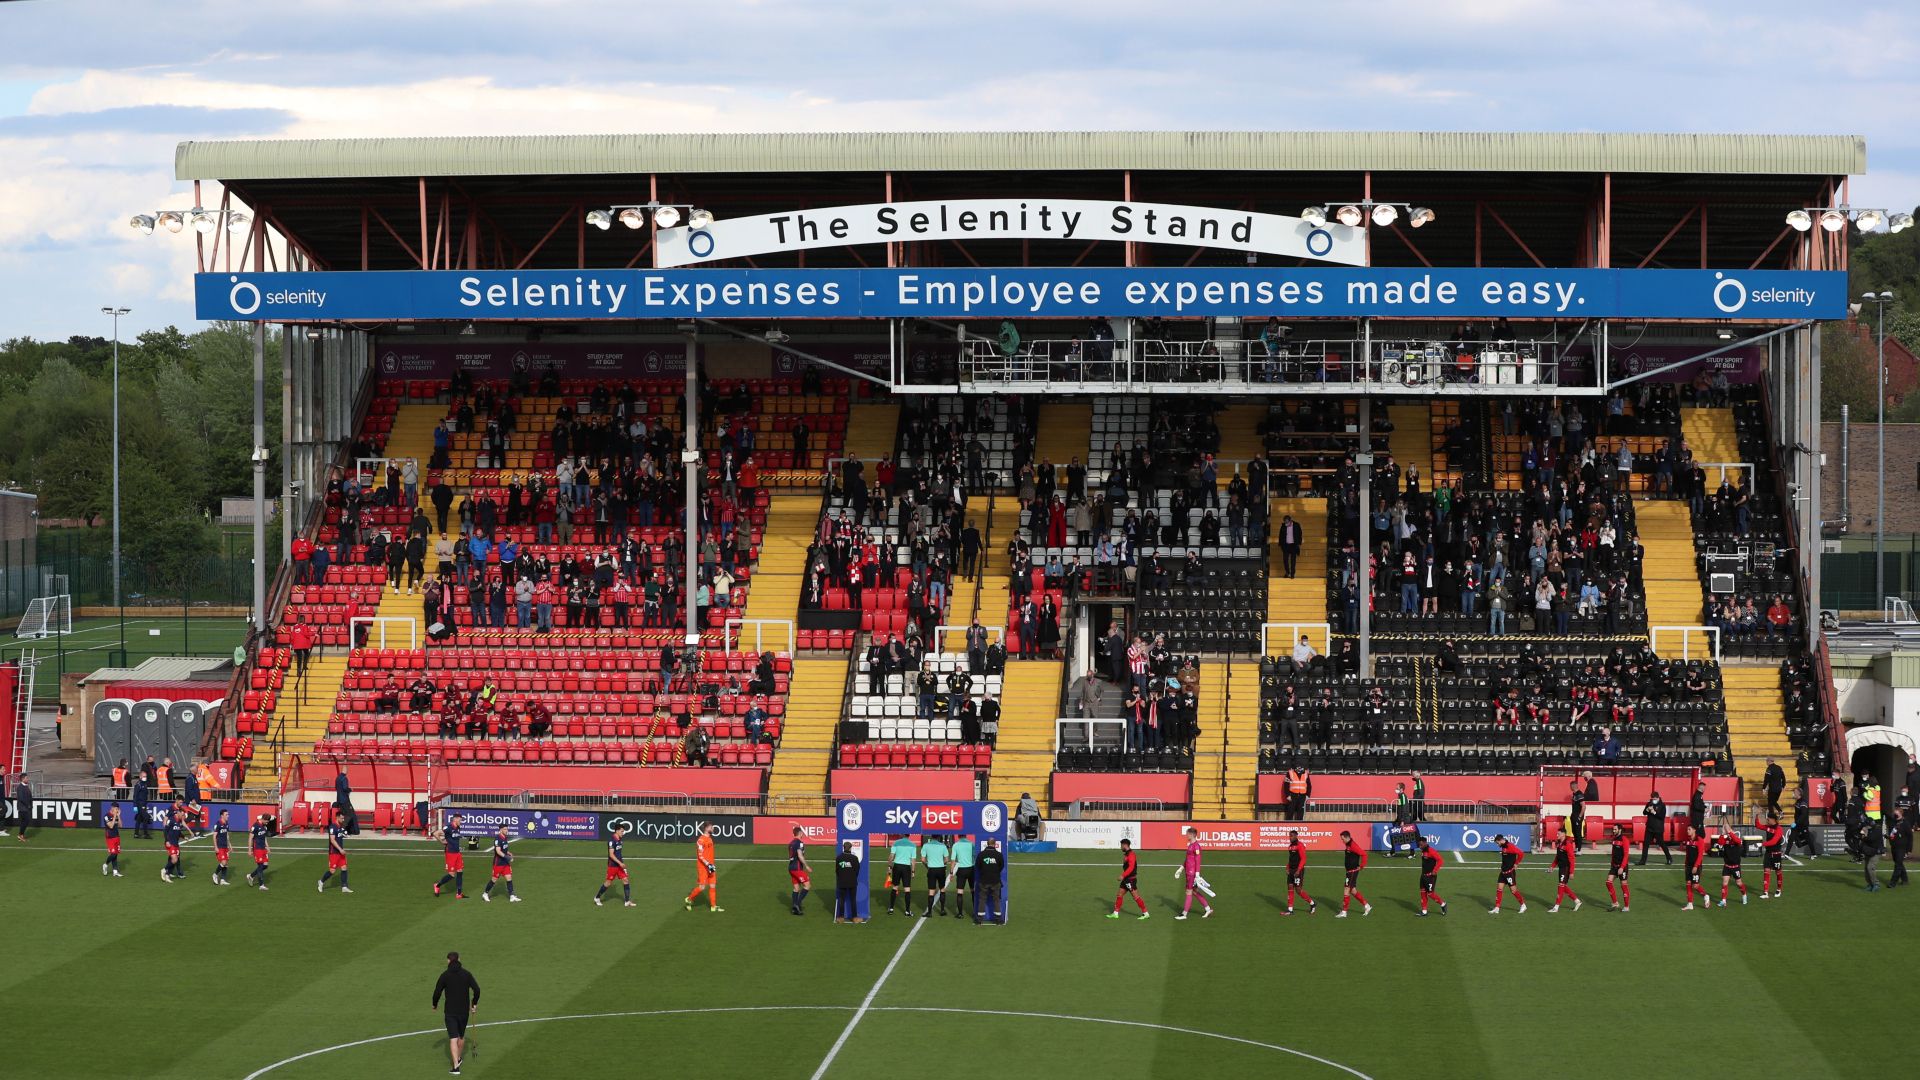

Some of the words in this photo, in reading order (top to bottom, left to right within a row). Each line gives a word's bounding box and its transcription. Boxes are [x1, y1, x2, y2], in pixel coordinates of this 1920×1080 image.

[769, 214, 849, 244] The
[876, 202, 1082, 239] Selenity
[1110, 205, 1253, 243] Stand
[266, 289, 327, 308] selenity
[459, 277, 627, 313] Selenity
[644, 276, 840, 313] Expenses
[898, 274, 1101, 312] Employee
[1125, 281, 1324, 312] expenses
[1347, 274, 1458, 304] made
[1481, 281, 1585, 312] easy.
[1751, 287, 1816, 307] selenity
[885, 805, 919, 828] sky
[925, 807, 959, 824] bet
[637, 819, 746, 840] KryptoKoud
[1072, 825, 1112, 833] education
[1195, 831, 1252, 841] UILDBASE
